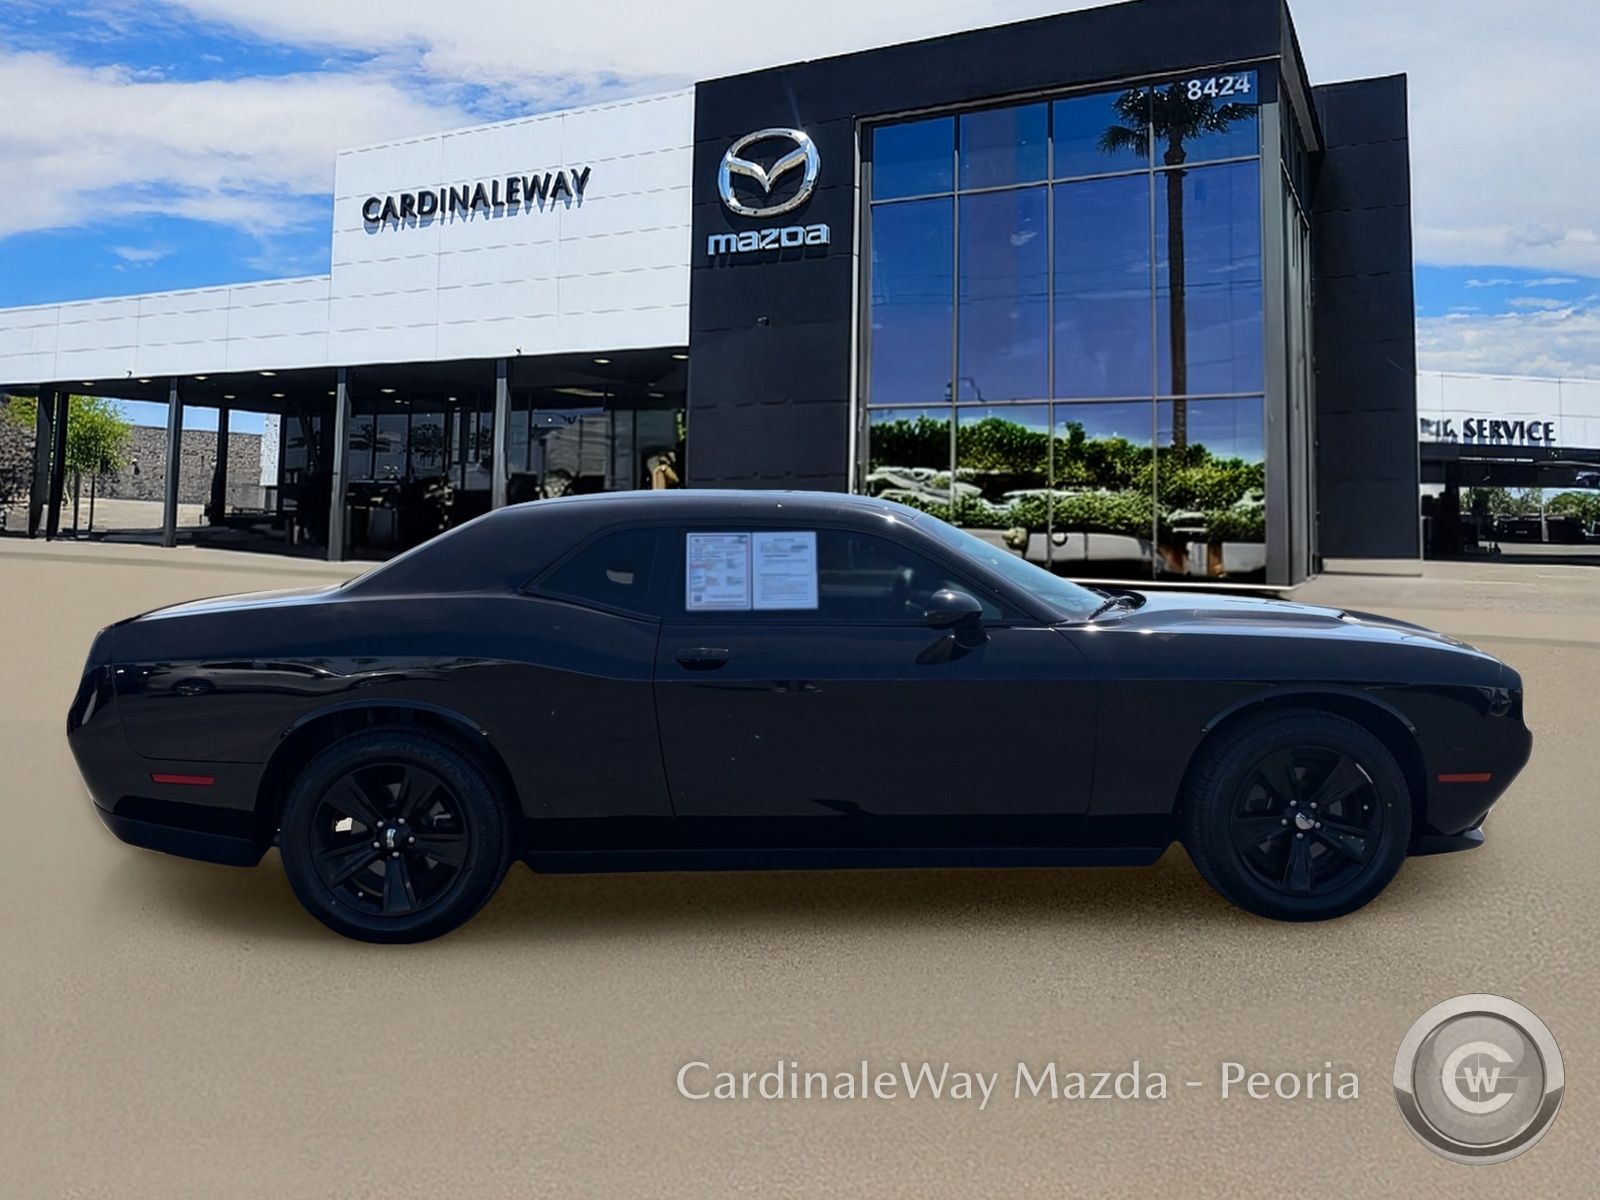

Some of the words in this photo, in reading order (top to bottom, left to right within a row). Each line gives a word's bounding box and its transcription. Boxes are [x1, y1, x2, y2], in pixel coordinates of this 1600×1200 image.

[1187, 74, 1251, 100] 8424
[362, 166, 592, 224] CARDINALEWAY
[1463, 417, 1557, 442] SERVICE
